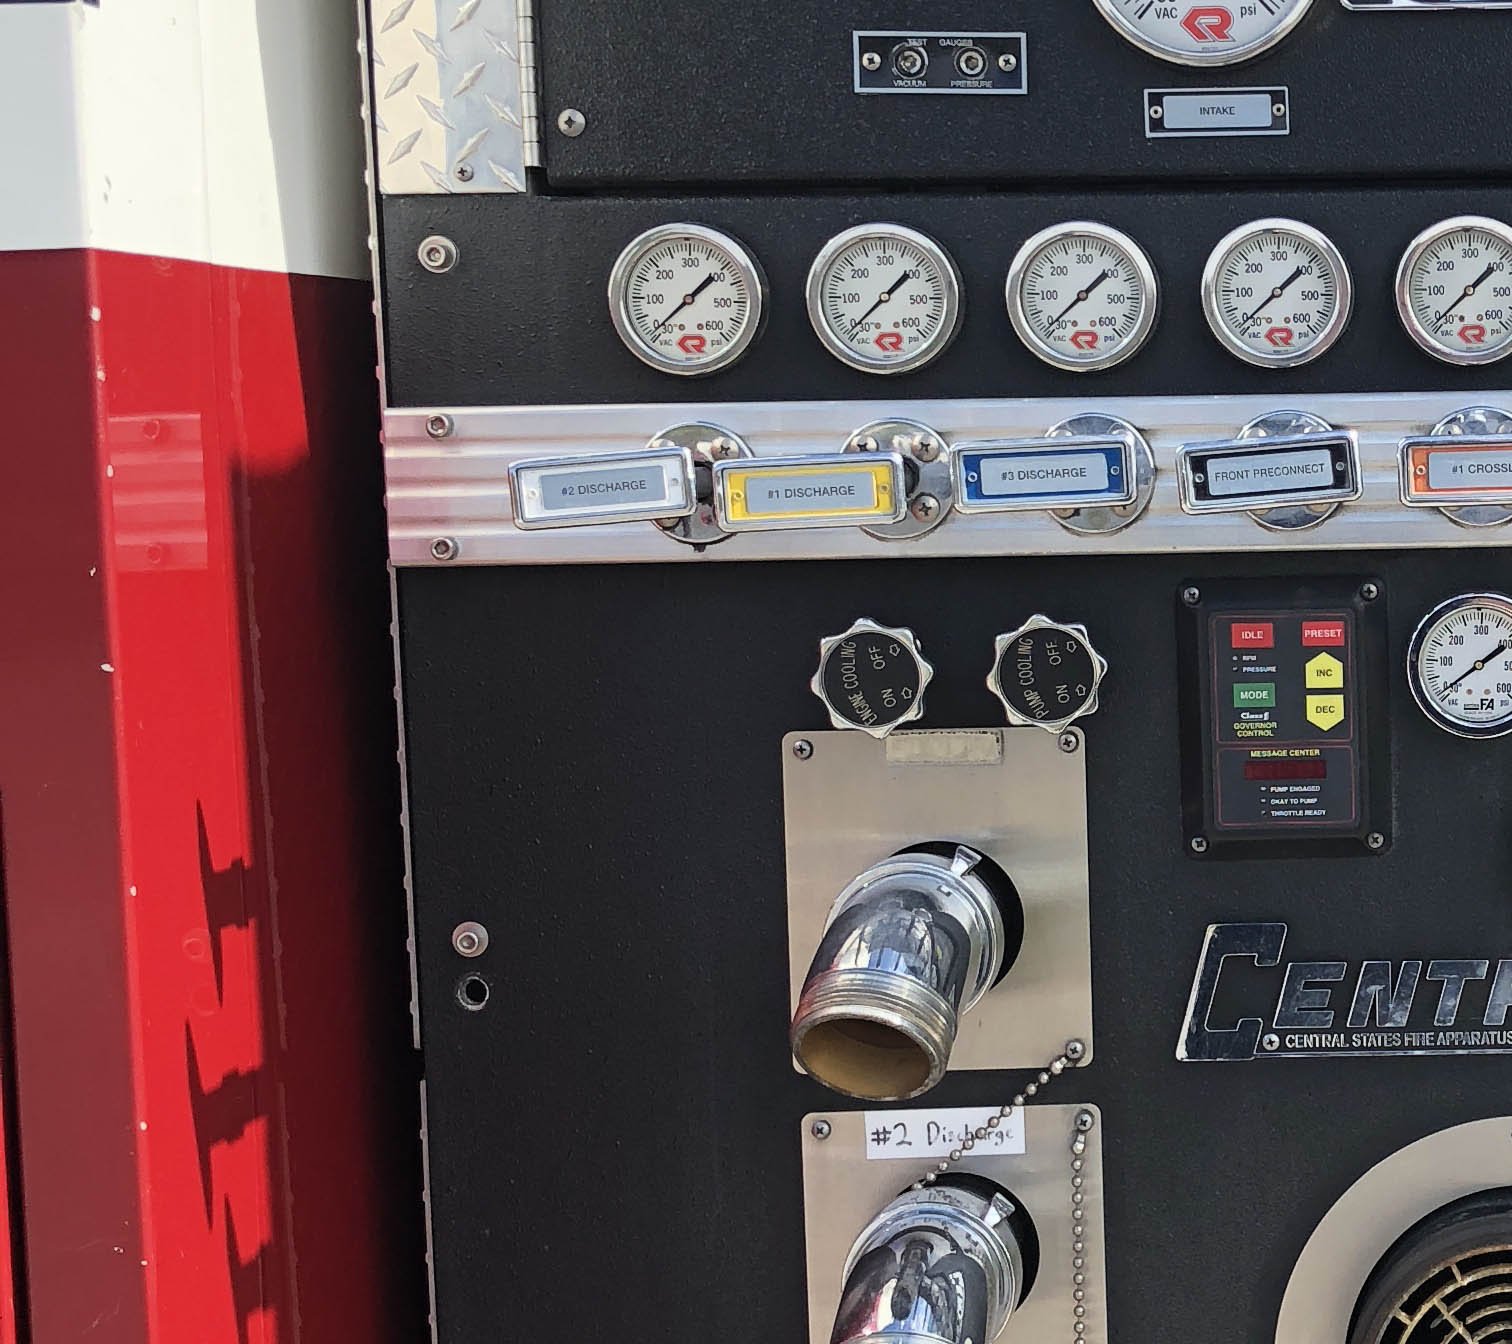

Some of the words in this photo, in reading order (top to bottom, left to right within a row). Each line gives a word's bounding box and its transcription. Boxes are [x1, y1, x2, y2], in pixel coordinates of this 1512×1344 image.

[1155, 8, 1178, 19] VAC
[1240, 4, 1257, 18] psi
[939, 39, 973, 47] GAUGES
[1200, 107, 1235, 115] INTAKE
[1270, 250, 1288, 261] 300
[1461, 248, 1479, 259] 300
[682, 257, 699, 268] 300
[1001, 471, 1015, 481] #3
[1018, 467, 1087, 481] DISCHARGE
[1215, 468, 1249, 482] FRONT
[1252, 463, 1326, 479] PRECONNECT
[1452, 464, 1464, 474] #1
[562, 486, 575, 496] #2
[578, 480, 647, 495] DISCHARGE
[768, 489, 782, 499] #1
[785, 485, 855, 499] DISCHARGE
[1242, 631, 1263, 639] IDLE
[1304, 629, 1342, 638] PRESET
[1474, 625, 1488, 635] 300
[868, 646, 885, 670] OFF
[1046, 642, 1061, 666] OFF
[840, 641, 859, 689] COOLING
[1017, 638, 1035, 687] COOLING
[1316, 669, 1333, 677] INC
[882, 688, 897, 708] ON
[1056, 684, 1070, 703] ON
[1240, 691, 1268, 699] MODE
[848, 691, 878, 726] ENGINE
[1024, 690, 1050, 719] PUMP
[1315, 706, 1335, 714] DEC
[1233, 722, 1277, 730] GOVERNOR
[1285, 1032, 1349, 1049] CENTRAL
[1352, 1032, 1402, 1047] STATES
[1404, 1031, 1435, 1047] FIRE
[871, 1122, 912, 1146] #2
[927, 1121, 1014, 1146] Dischrge
